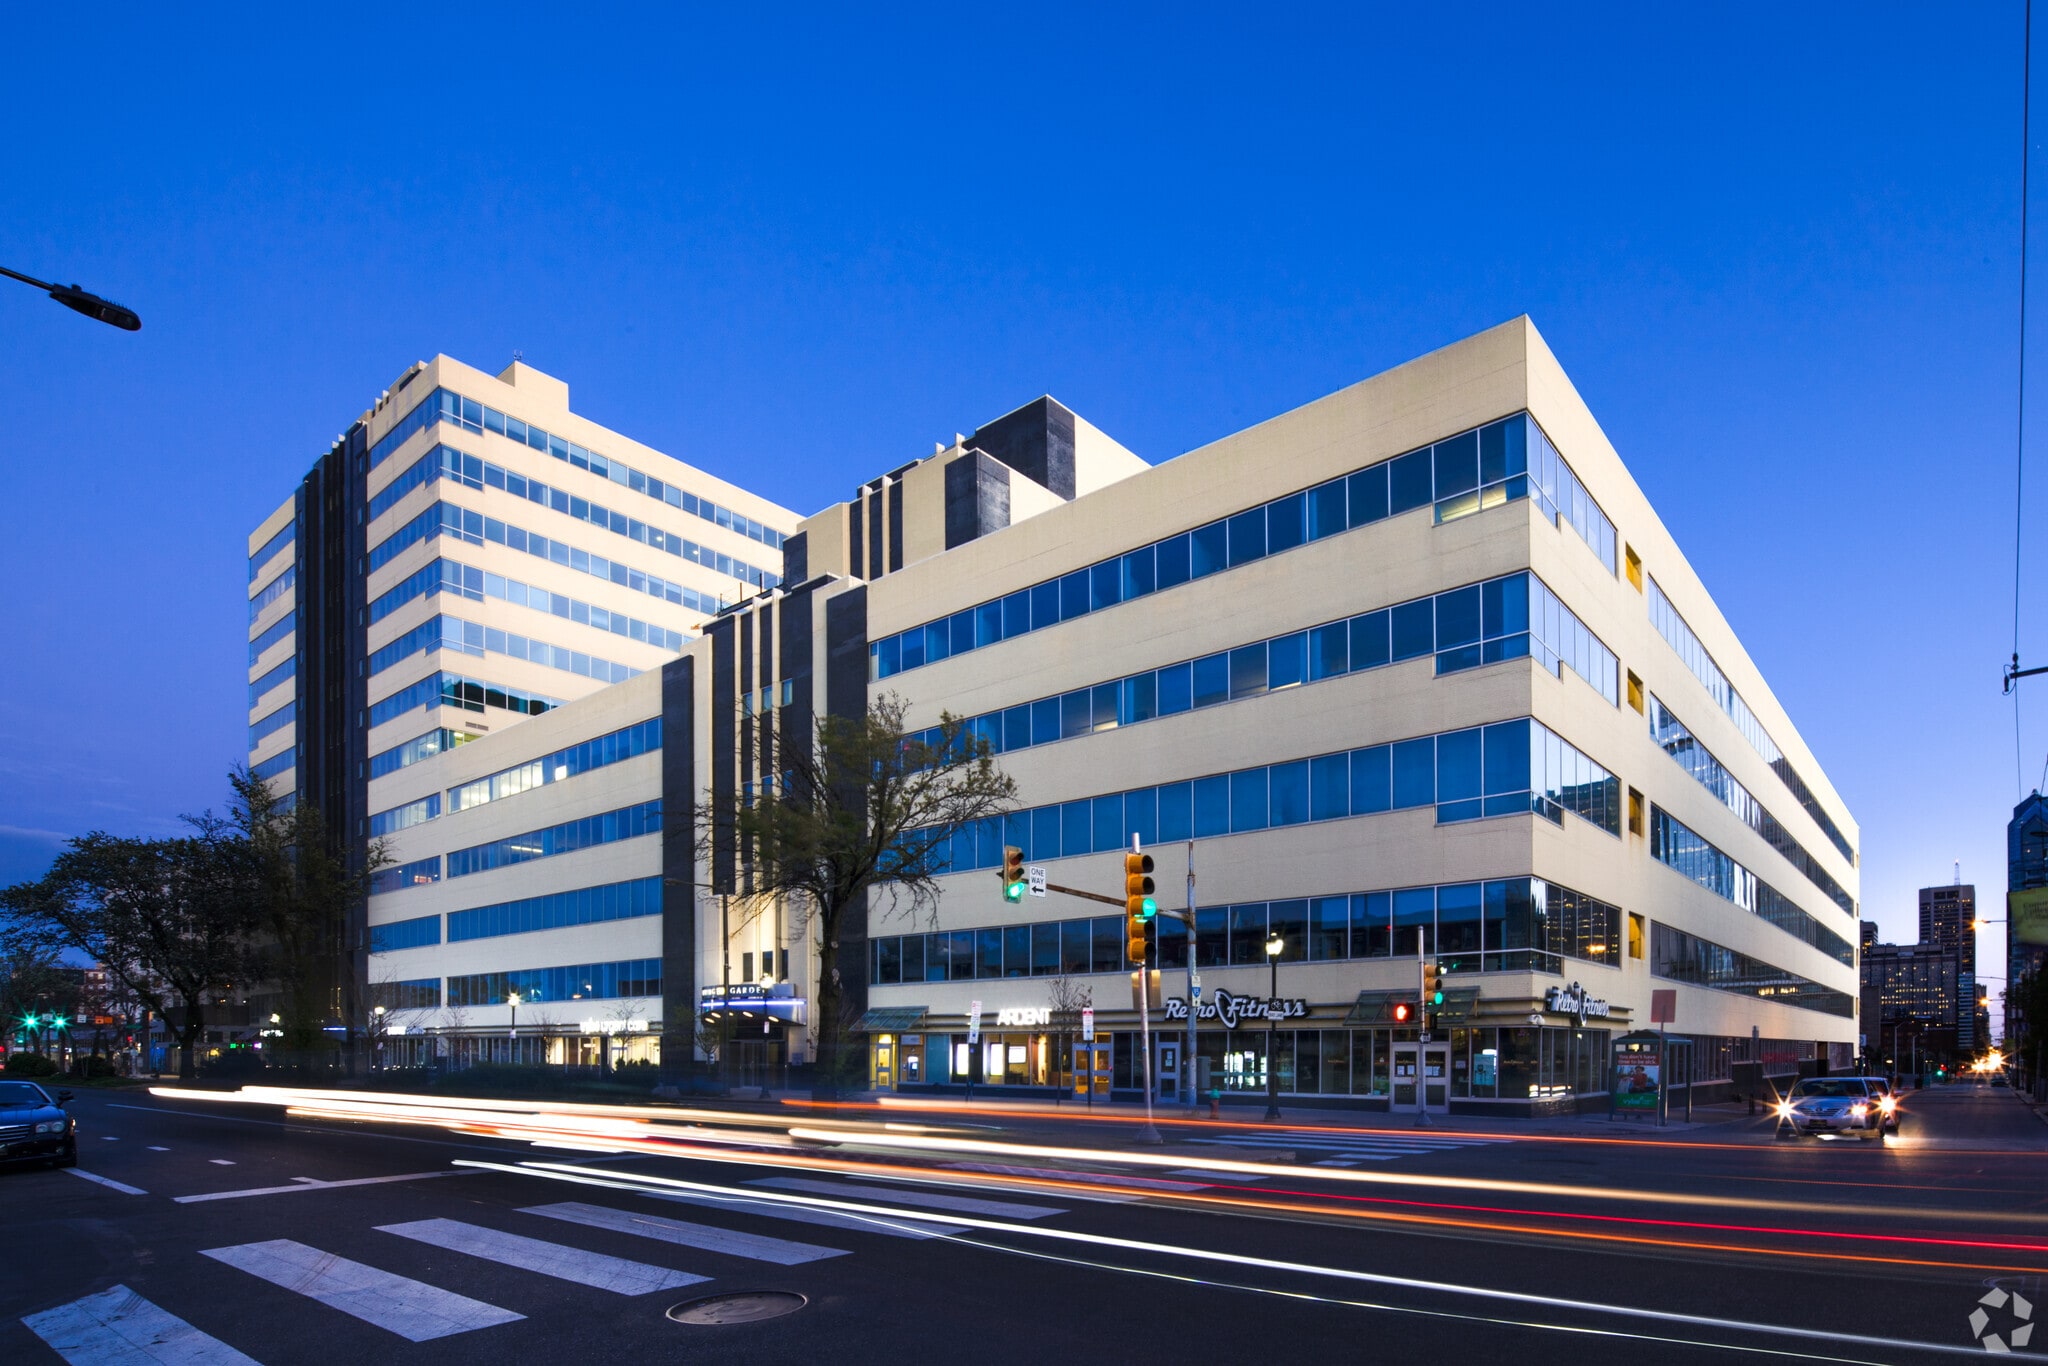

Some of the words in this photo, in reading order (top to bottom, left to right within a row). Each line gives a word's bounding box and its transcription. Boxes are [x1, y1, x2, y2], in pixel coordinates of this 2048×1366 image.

[1031, 868, 1045, 877] ONE
[729, 986, 766, 996] GARDE
[1166, 999, 1216, 1018] Rero
[1227, 998, 1306, 1018] Fitnss
[1556, 990, 1579, 1013] Retro
[997, 1008, 1052, 1025] ARDENT
